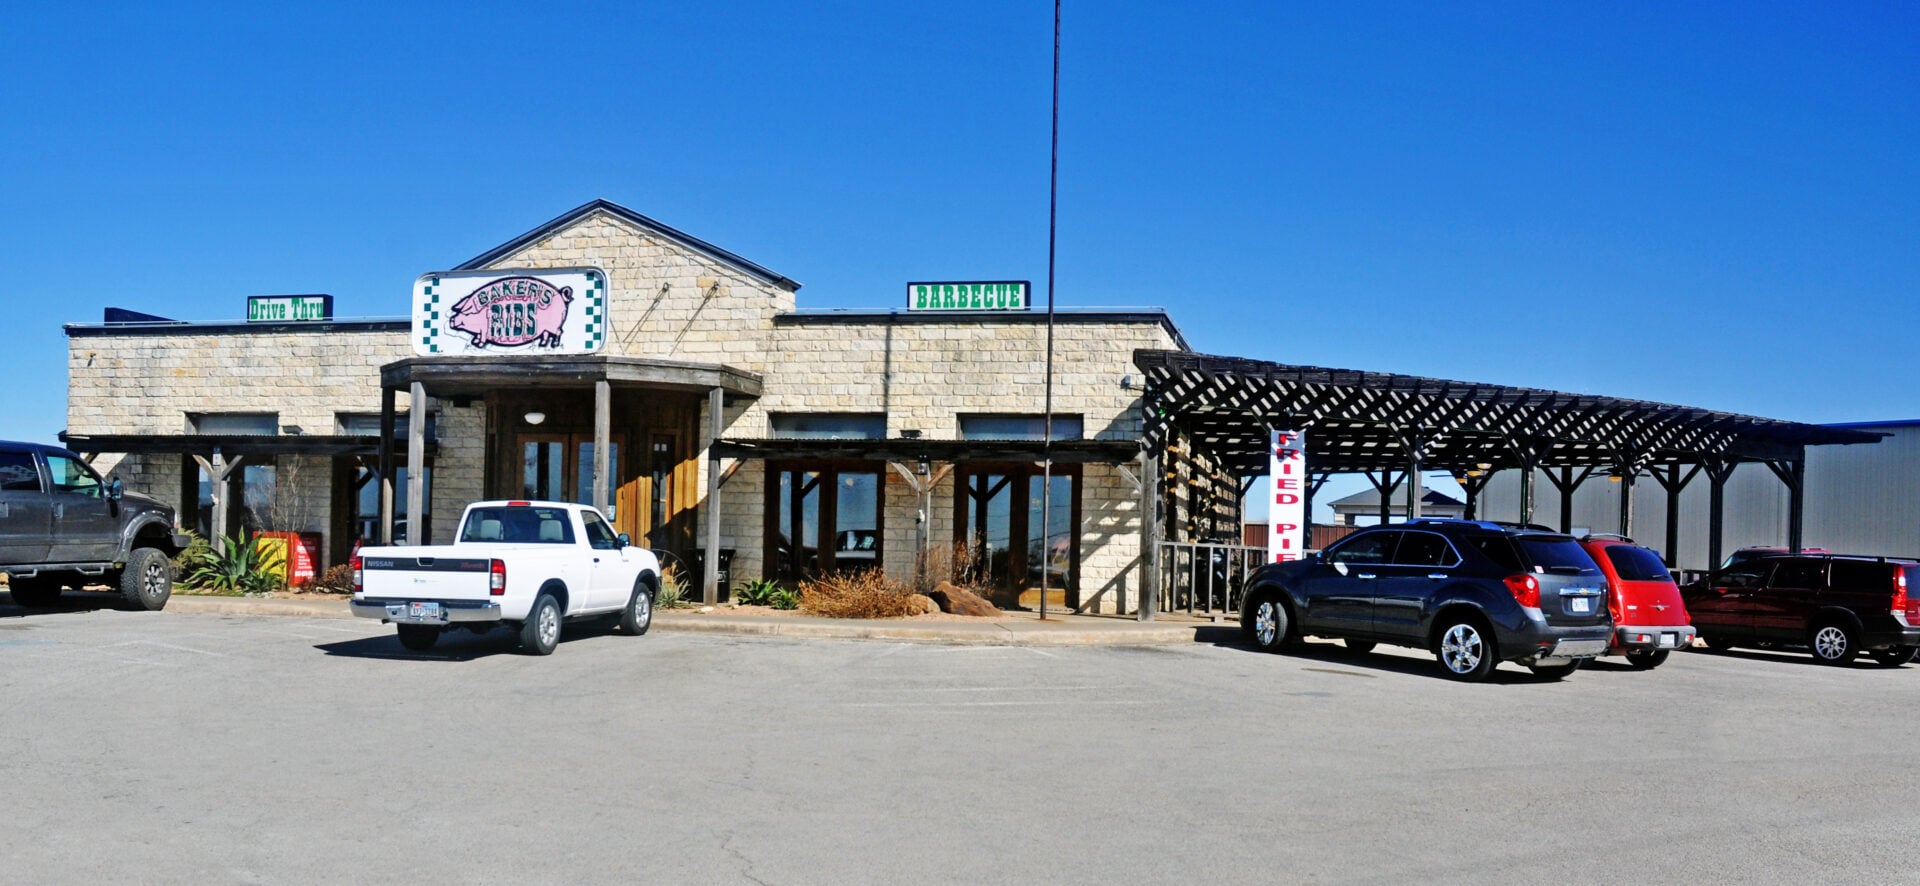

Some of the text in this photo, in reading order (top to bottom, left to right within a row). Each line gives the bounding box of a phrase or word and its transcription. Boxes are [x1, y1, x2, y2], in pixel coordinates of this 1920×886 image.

[477, 280, 554, 305] BAKER'S
[916, 284, 1020, 309] BARBECUE
[249, 297, 324, 320] Drive Thru
[490, 302, 537, 337] RIBS
[1275, 433, 1300, 505] FRIED
[367, 560, 394, 568] NISSAN
